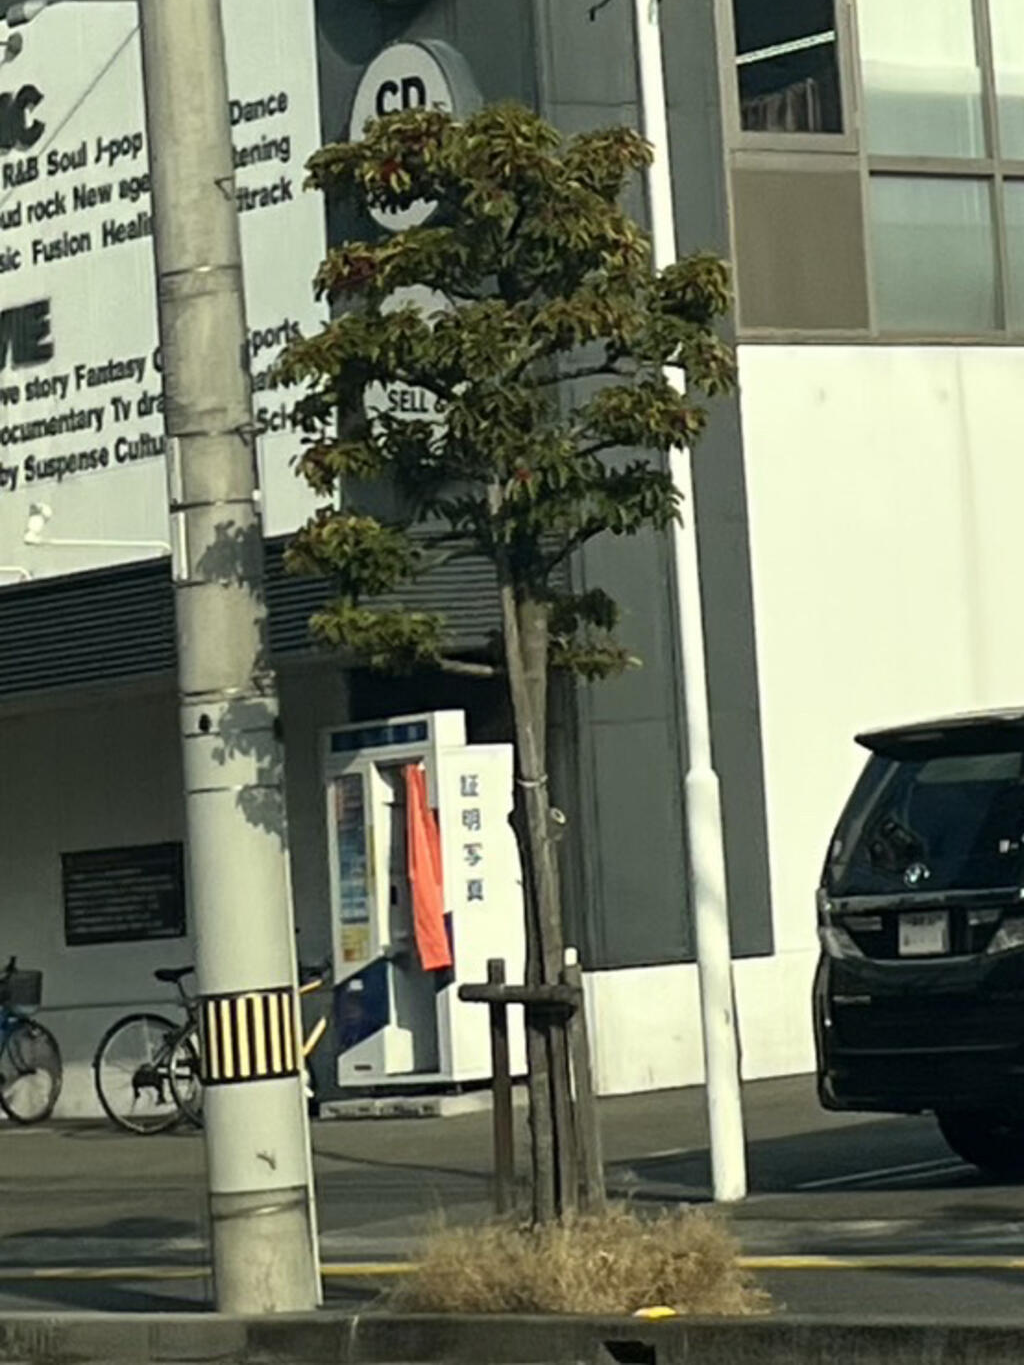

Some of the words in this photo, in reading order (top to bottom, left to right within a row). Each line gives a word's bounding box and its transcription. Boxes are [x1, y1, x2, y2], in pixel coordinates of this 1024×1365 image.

[376, 76, 426, 118] CD
[3, 156, 39, 190] R&B
[47, 140, 87, 176] Soul
[95, 132, 142, 166] J-pop
[229, 91, 288, 126] Dance
[27, 191, 66, 224] rock
[73, 183, 112, 212] New
[32, 231, 91, 265] Fusion
[25, 375, 69, 401] story
[74, 357, 146, 391] Fantasy
[387, 389, 429, 414] SELL
[24, 447, 109, 483] Suspense
